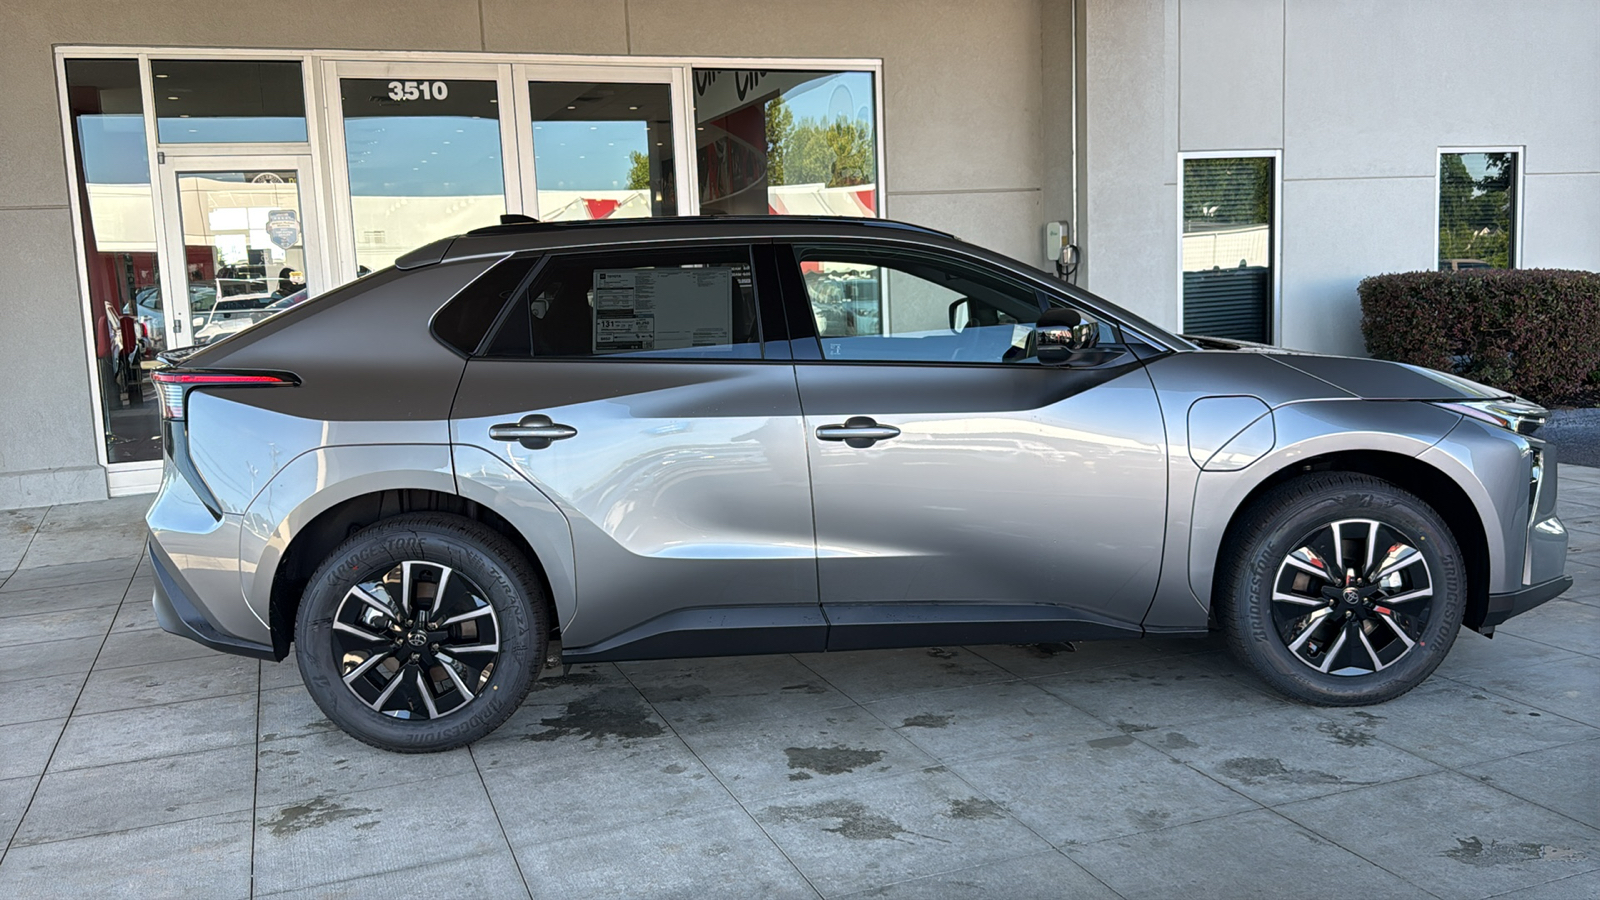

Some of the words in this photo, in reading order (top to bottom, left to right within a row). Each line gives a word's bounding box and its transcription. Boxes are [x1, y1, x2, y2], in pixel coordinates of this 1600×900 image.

[388, 81, 448, 100] 3510
[601, 320, 614, 328] 131
[327, 537, 427, 584] BRIDGESTONE
[488, 567, 525, 636] TURANZA
[1249, 541, 1276, 642] BRIDGESTONE
[1430, 554, 1458, 652] BRIDGESTONE
[407, 699, 504, 743] BRIDGESTONE
